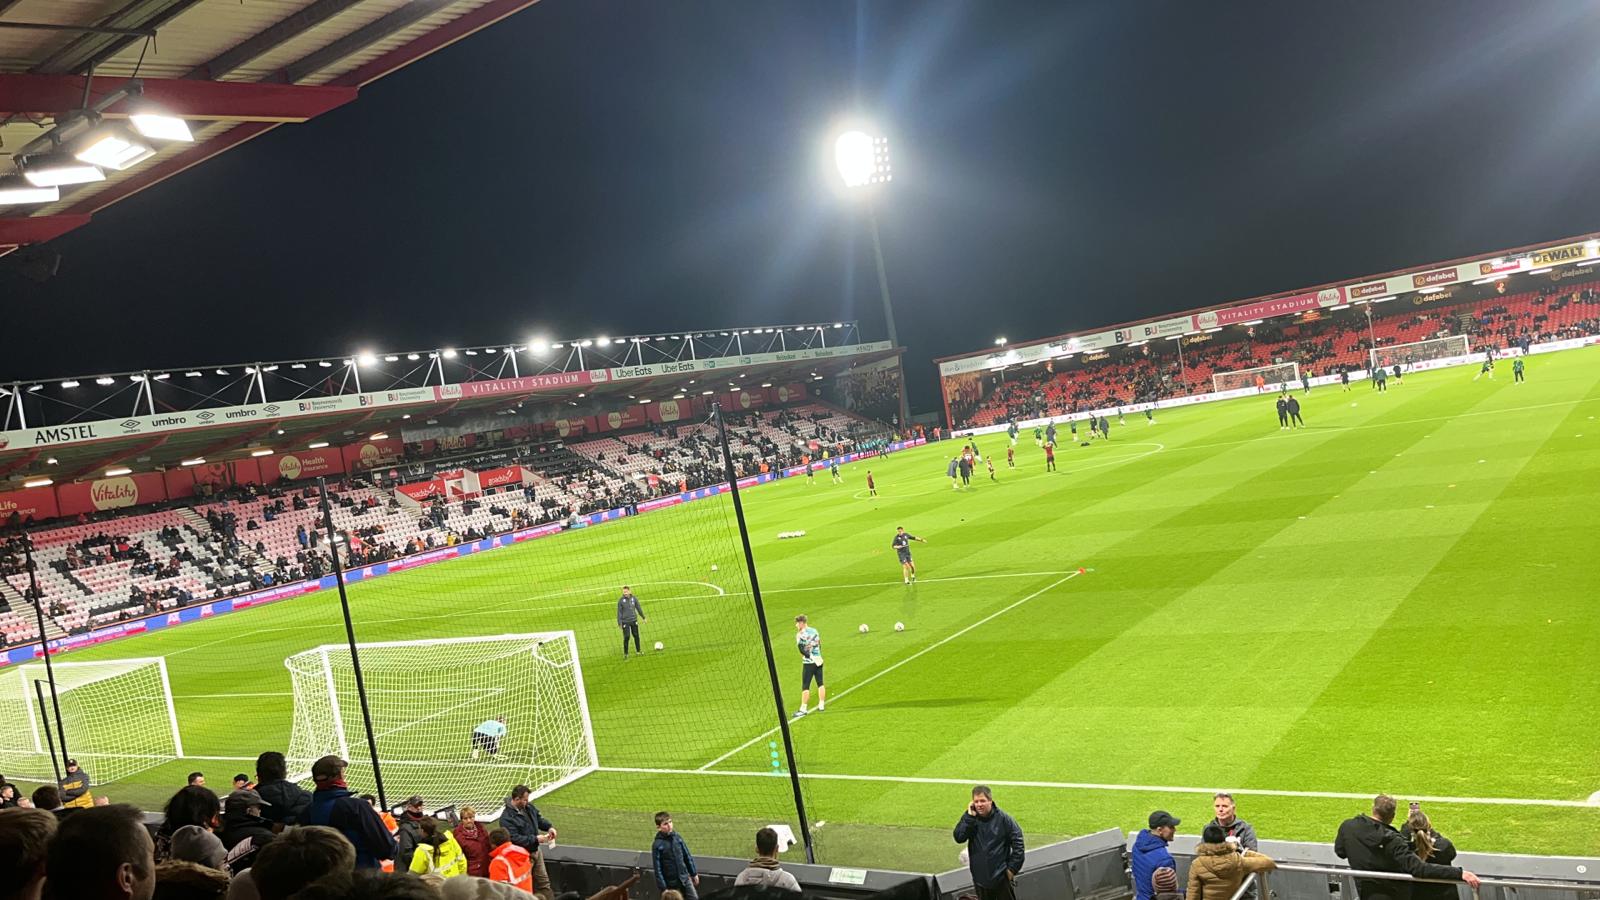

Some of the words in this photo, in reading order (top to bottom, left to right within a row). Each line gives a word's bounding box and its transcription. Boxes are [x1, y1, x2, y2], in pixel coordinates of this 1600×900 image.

[1425, 271, 1456, 283] dafabet
[1562, 267, 1593, 277] dafabet
[1361, 284, 1385, 295] dafabet
[1423, 292, 1453, 303] dafabet
[1221, 307, 1265, 320] VITALITY
[1270, 298, 1314, 312] STADIUM
[1115, 328, 1133, 343] BU
[1144, 326, 1158, 336] BU
[616, 368, 634, 378] Uber
[634, 366, 653, 376] Eats
[660, 363, 678, 373] Uber
[678, 362, 695, 372] Eats
[471, 380, 525, 394] VITALITY
[532, 374, 579, 387] STADIUM
[359, 395, 374, 406] BU
[388, 393, 399, 402] BU
[299, 402, 312, 411] BU
[225, 408, 257, 419] umbro
[152, 416, 187, 428] umbro
[35, 424, 98, 445] AMSTEL
[301, 456, 325, 466] Health
[92, 483, 137, 503] Vitality
[0, 501, 18, 509] Life
[0, 508, 37, 518] insance
[89, 626, 123, 639] Insurance
